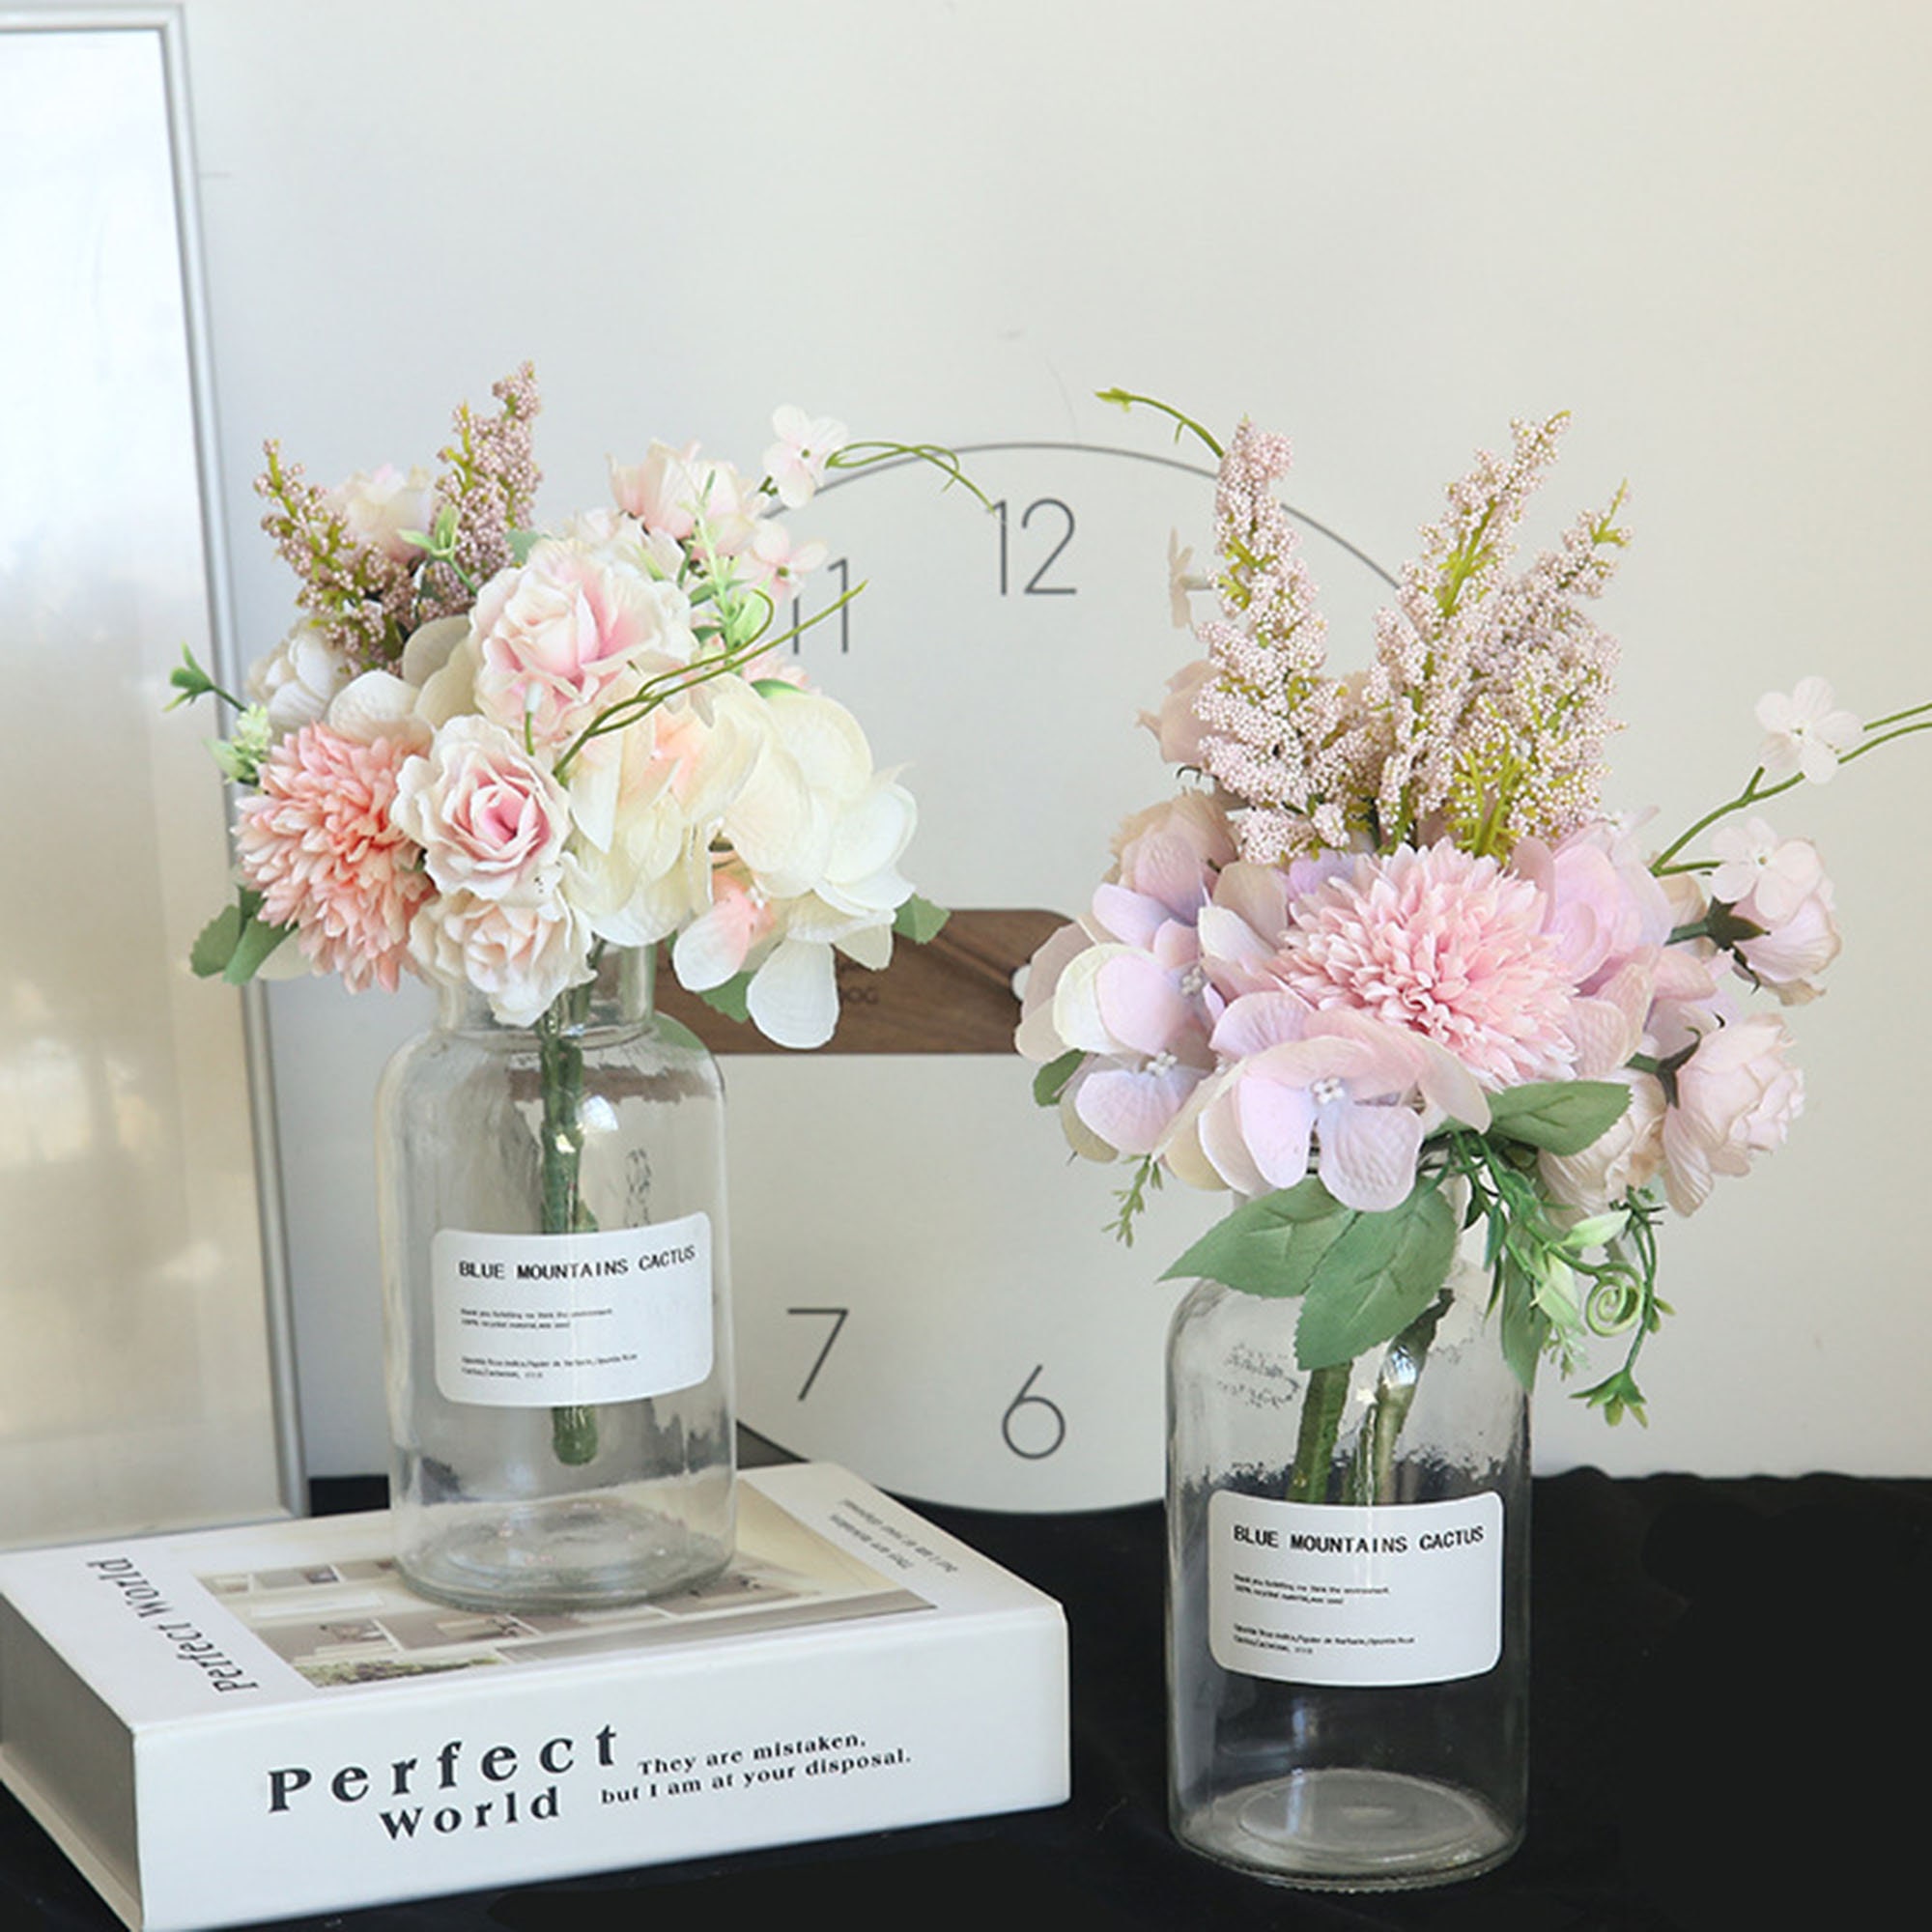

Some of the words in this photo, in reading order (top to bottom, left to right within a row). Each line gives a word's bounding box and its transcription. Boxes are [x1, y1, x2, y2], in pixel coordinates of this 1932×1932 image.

[986, 497, 1077, 596] 12
[459, 1260, 506, 1279] BLUE
[517, 1259, 629, 1281] MOUNTAINS
[639, 1245, 696, 1271] CACTUS
[787, 1308, 848, 1402] 7
[1002, 1364, 1065, 1461] 6
[1234, 1524, 1279, 1548] BLUE
[1290, 1533, 1408, 1554] MOUNTAINS
[1419, 1525, 1485, 1552] CACTUS
[86, 1557, 173, 1618] World
[156, 1622, 259, 1692] Perfect
[268, 1723, 617, 1813] Perfect
[601, 1787, 639, 1804] but
[649, 1783, 658, 1799] I
[668, 1779, 701, 1797] am
[712, 1773, 734, 1789] at
[743, 1764, 797, 1788] your
[805, 1747, 912, 1776] disposal.
[639, 1756, 696, 1776] They
[706, 1750, 743, 1768] are
